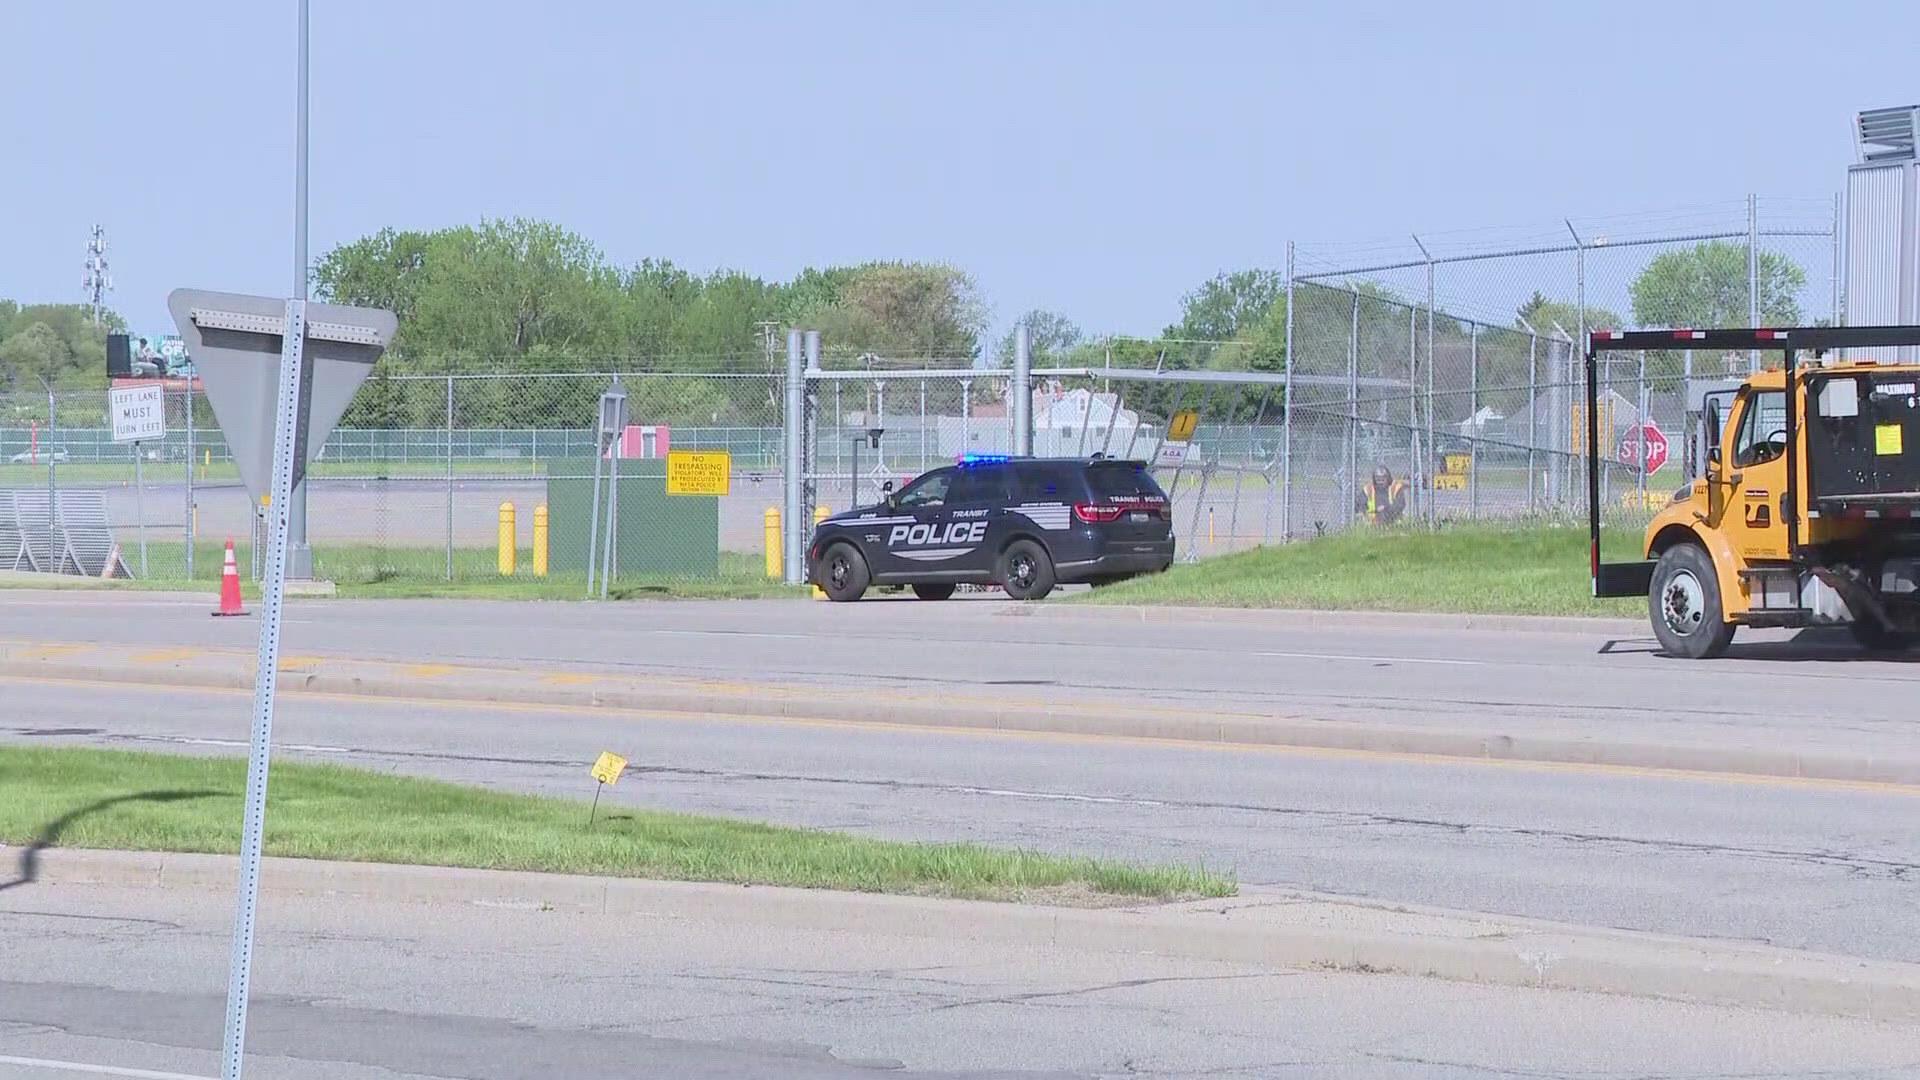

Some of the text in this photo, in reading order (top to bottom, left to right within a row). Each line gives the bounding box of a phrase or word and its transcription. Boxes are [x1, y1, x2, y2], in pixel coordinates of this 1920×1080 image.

[1875, 383, 1916, 396] MAXIMUM
[115, 391, 159, 404] LEFT LANE
[124, 407, 151, 419] MUST
[116, 422, 160, 435] TURN LEFT
[952, 509, 989, 518] TRANSIT
[888, 521, 989, 546] POLICE
